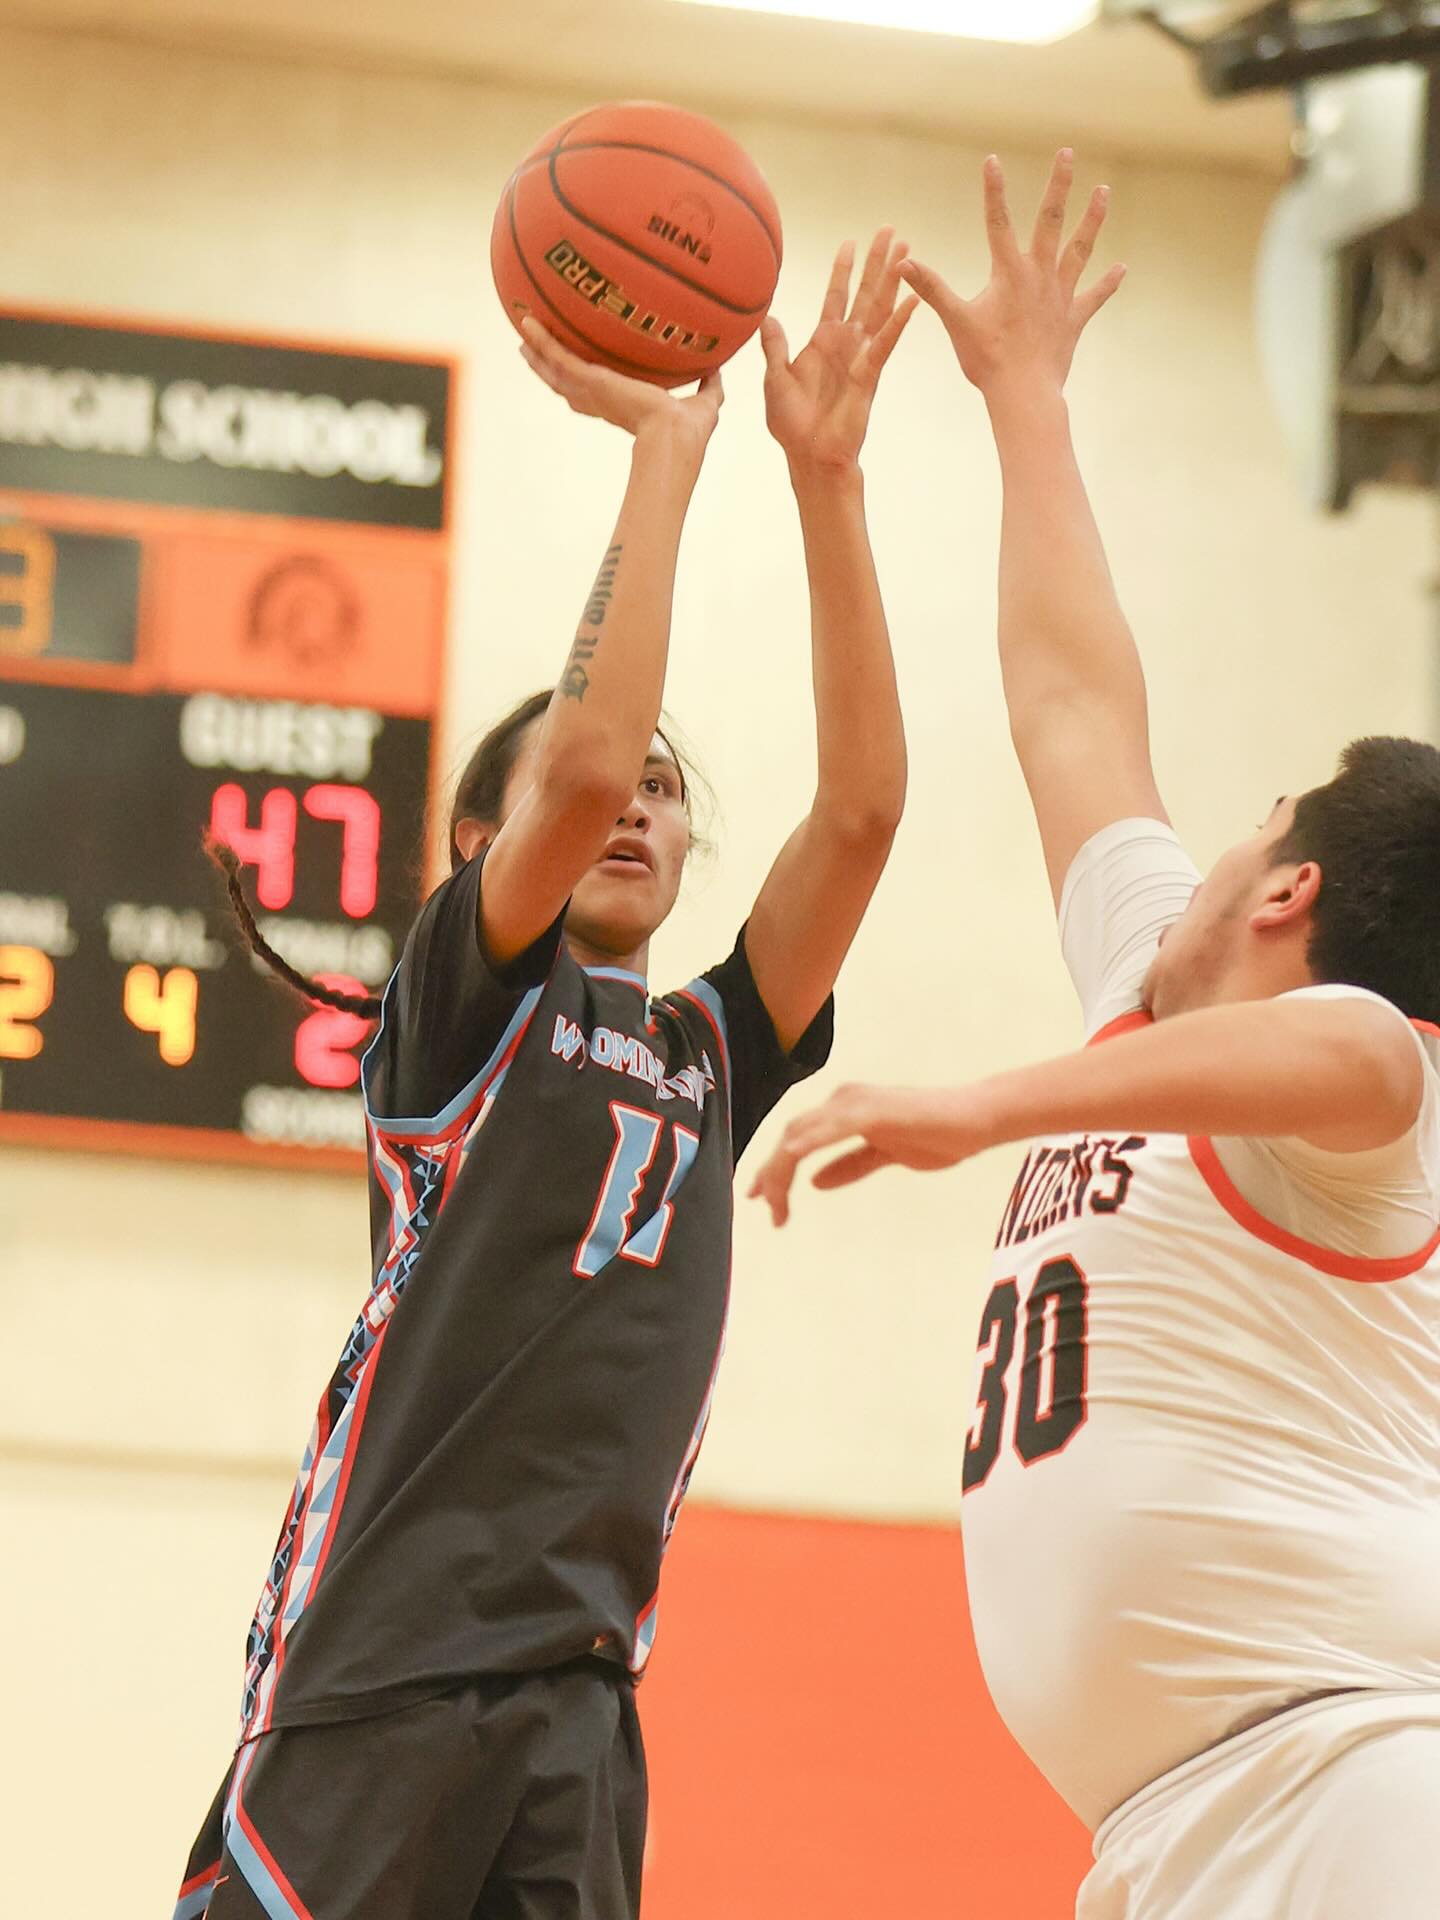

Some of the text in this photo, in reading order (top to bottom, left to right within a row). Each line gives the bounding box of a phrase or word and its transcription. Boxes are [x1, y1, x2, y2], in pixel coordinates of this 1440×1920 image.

[545, 240, 609, 303] PRO
[156, 380, 442, 487] SCHOOL
[181, 693, 383, 781] GUEST
[208, 783, 381, 918] 47
[124, 964, 198, 1066] 4
[573, 1099, 700, 1279] 11
[961, 1253, 1088, 1496] 30
